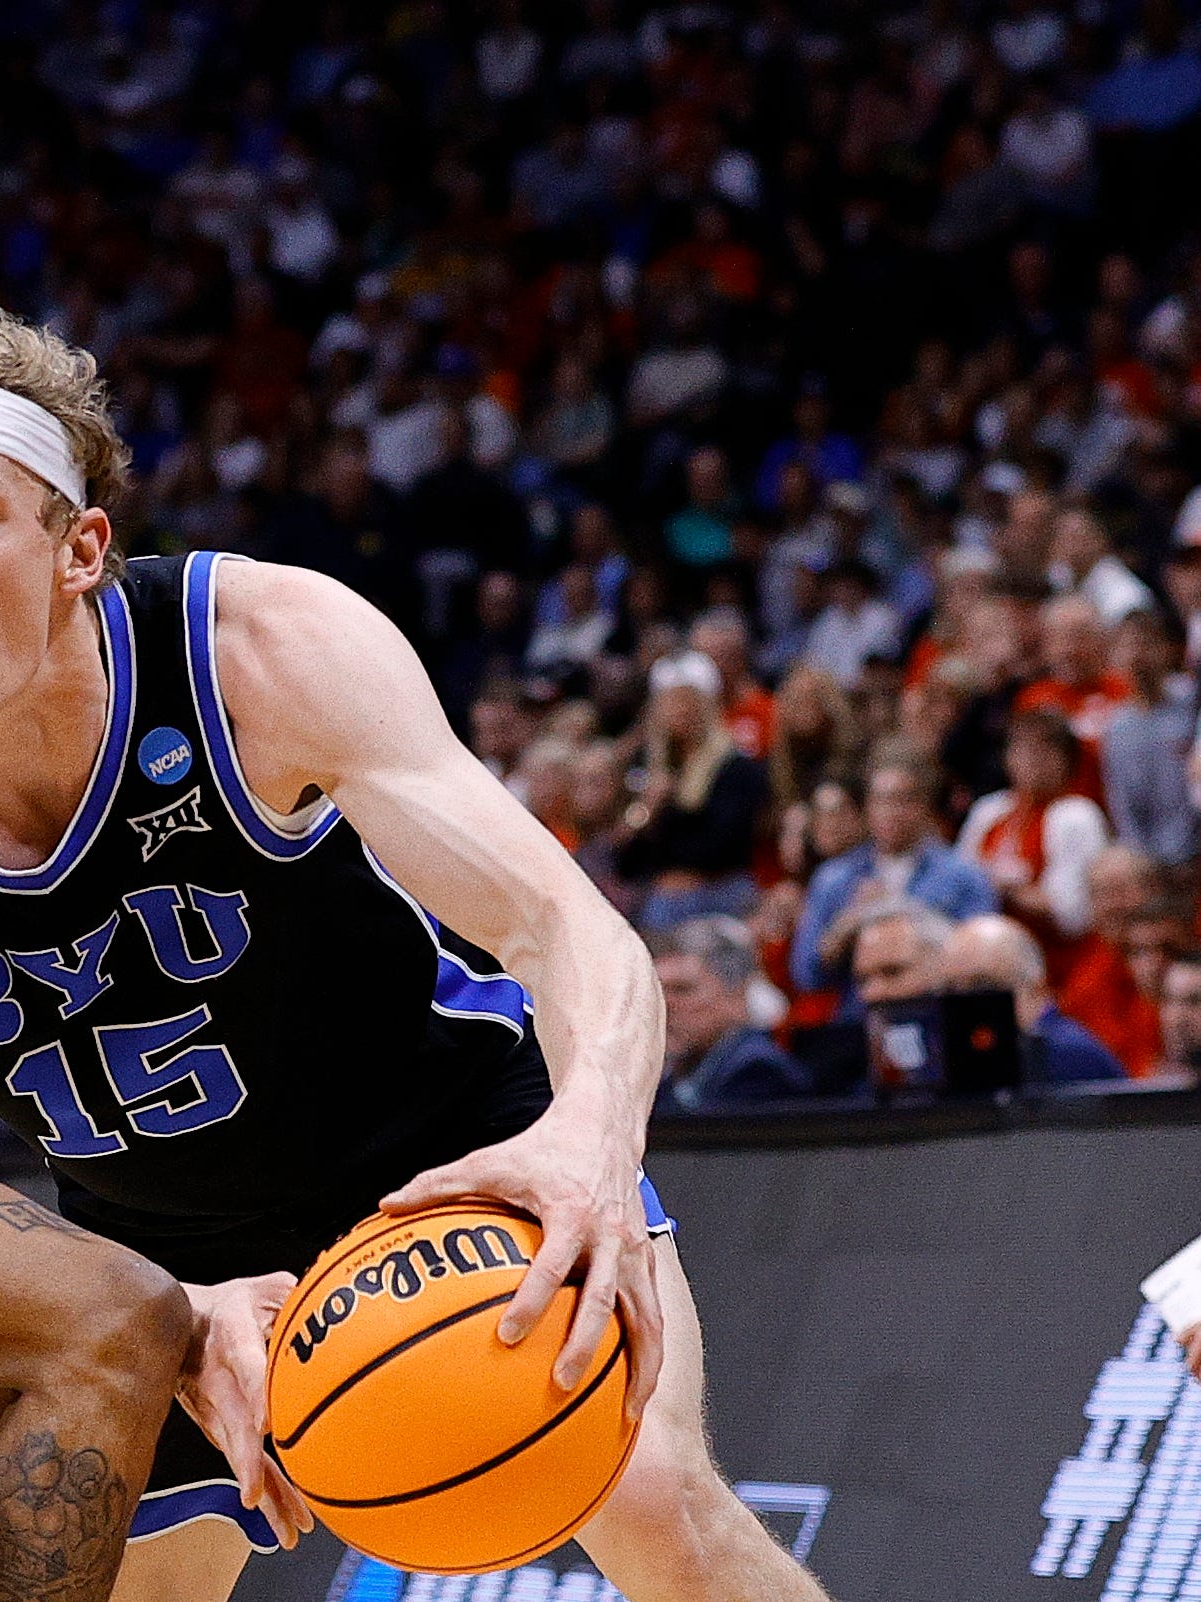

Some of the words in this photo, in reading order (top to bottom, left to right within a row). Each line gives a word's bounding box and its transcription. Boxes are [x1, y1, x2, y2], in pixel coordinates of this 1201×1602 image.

[149, 744, 191, 778] NCAA
[4, 1003, 248, 1158] 15
[290, 1225, 533, 1363] Wilson
